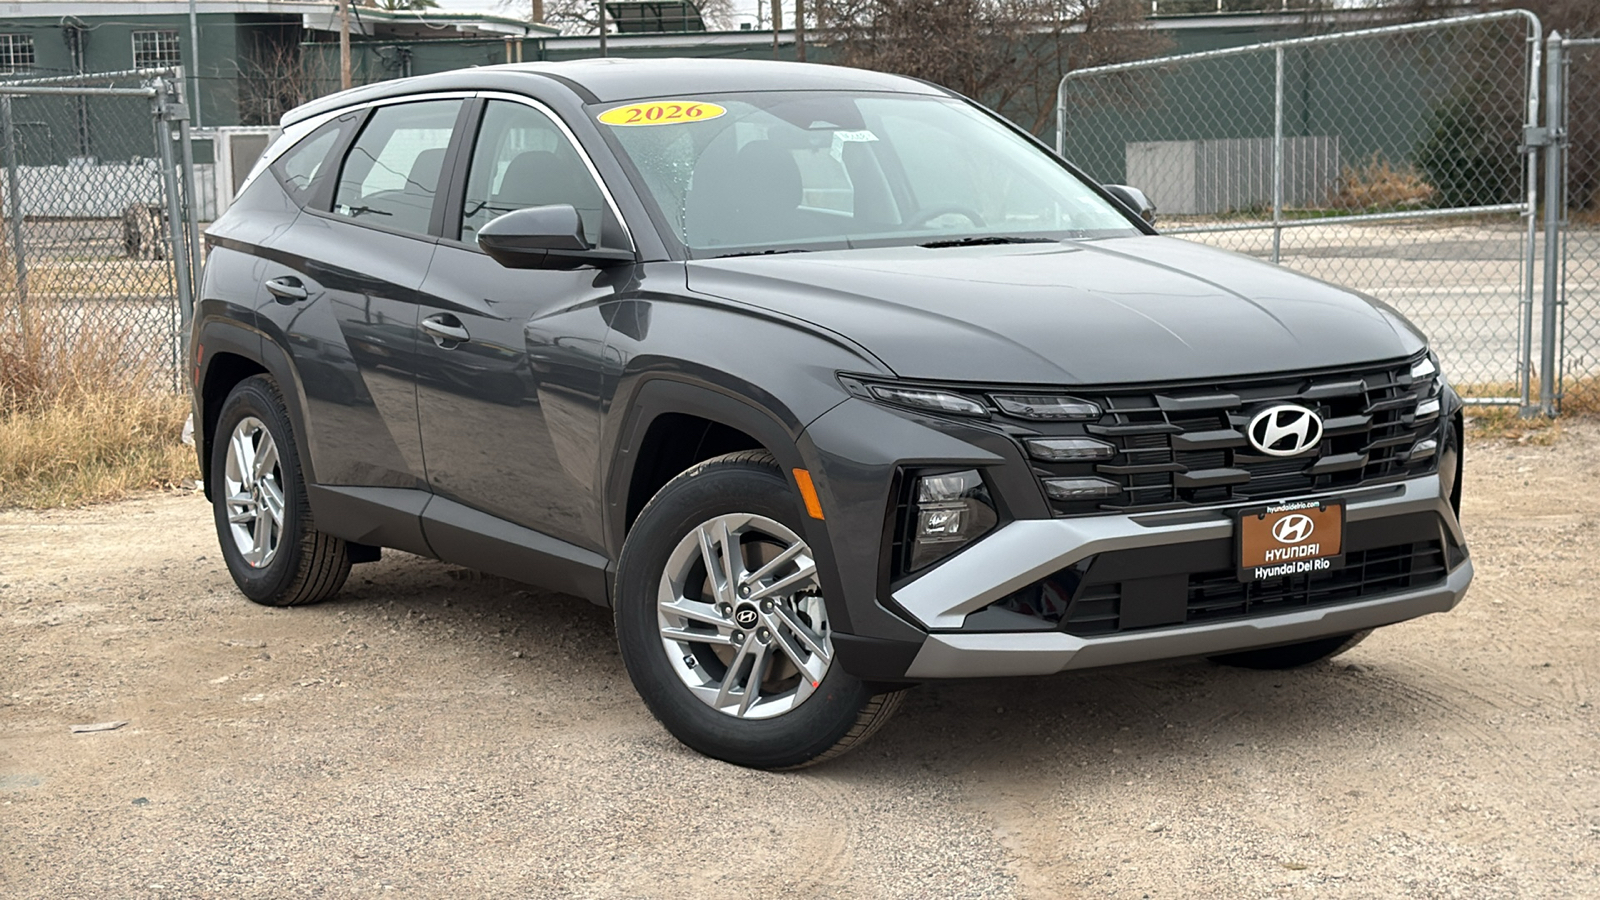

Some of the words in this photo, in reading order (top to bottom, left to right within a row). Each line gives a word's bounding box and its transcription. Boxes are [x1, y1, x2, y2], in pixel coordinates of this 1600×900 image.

[625, 104, 703, 123] 2026
[1267, 501, 1320, 513] hyundaidelrio.com
[1265, 543, 1320, 561] HYUNDAI
[1255, 563, 1296, 580] Hyundai
[1297, 560, 1313, 573] Del
[1314, 558, 1330, 570] Rio
